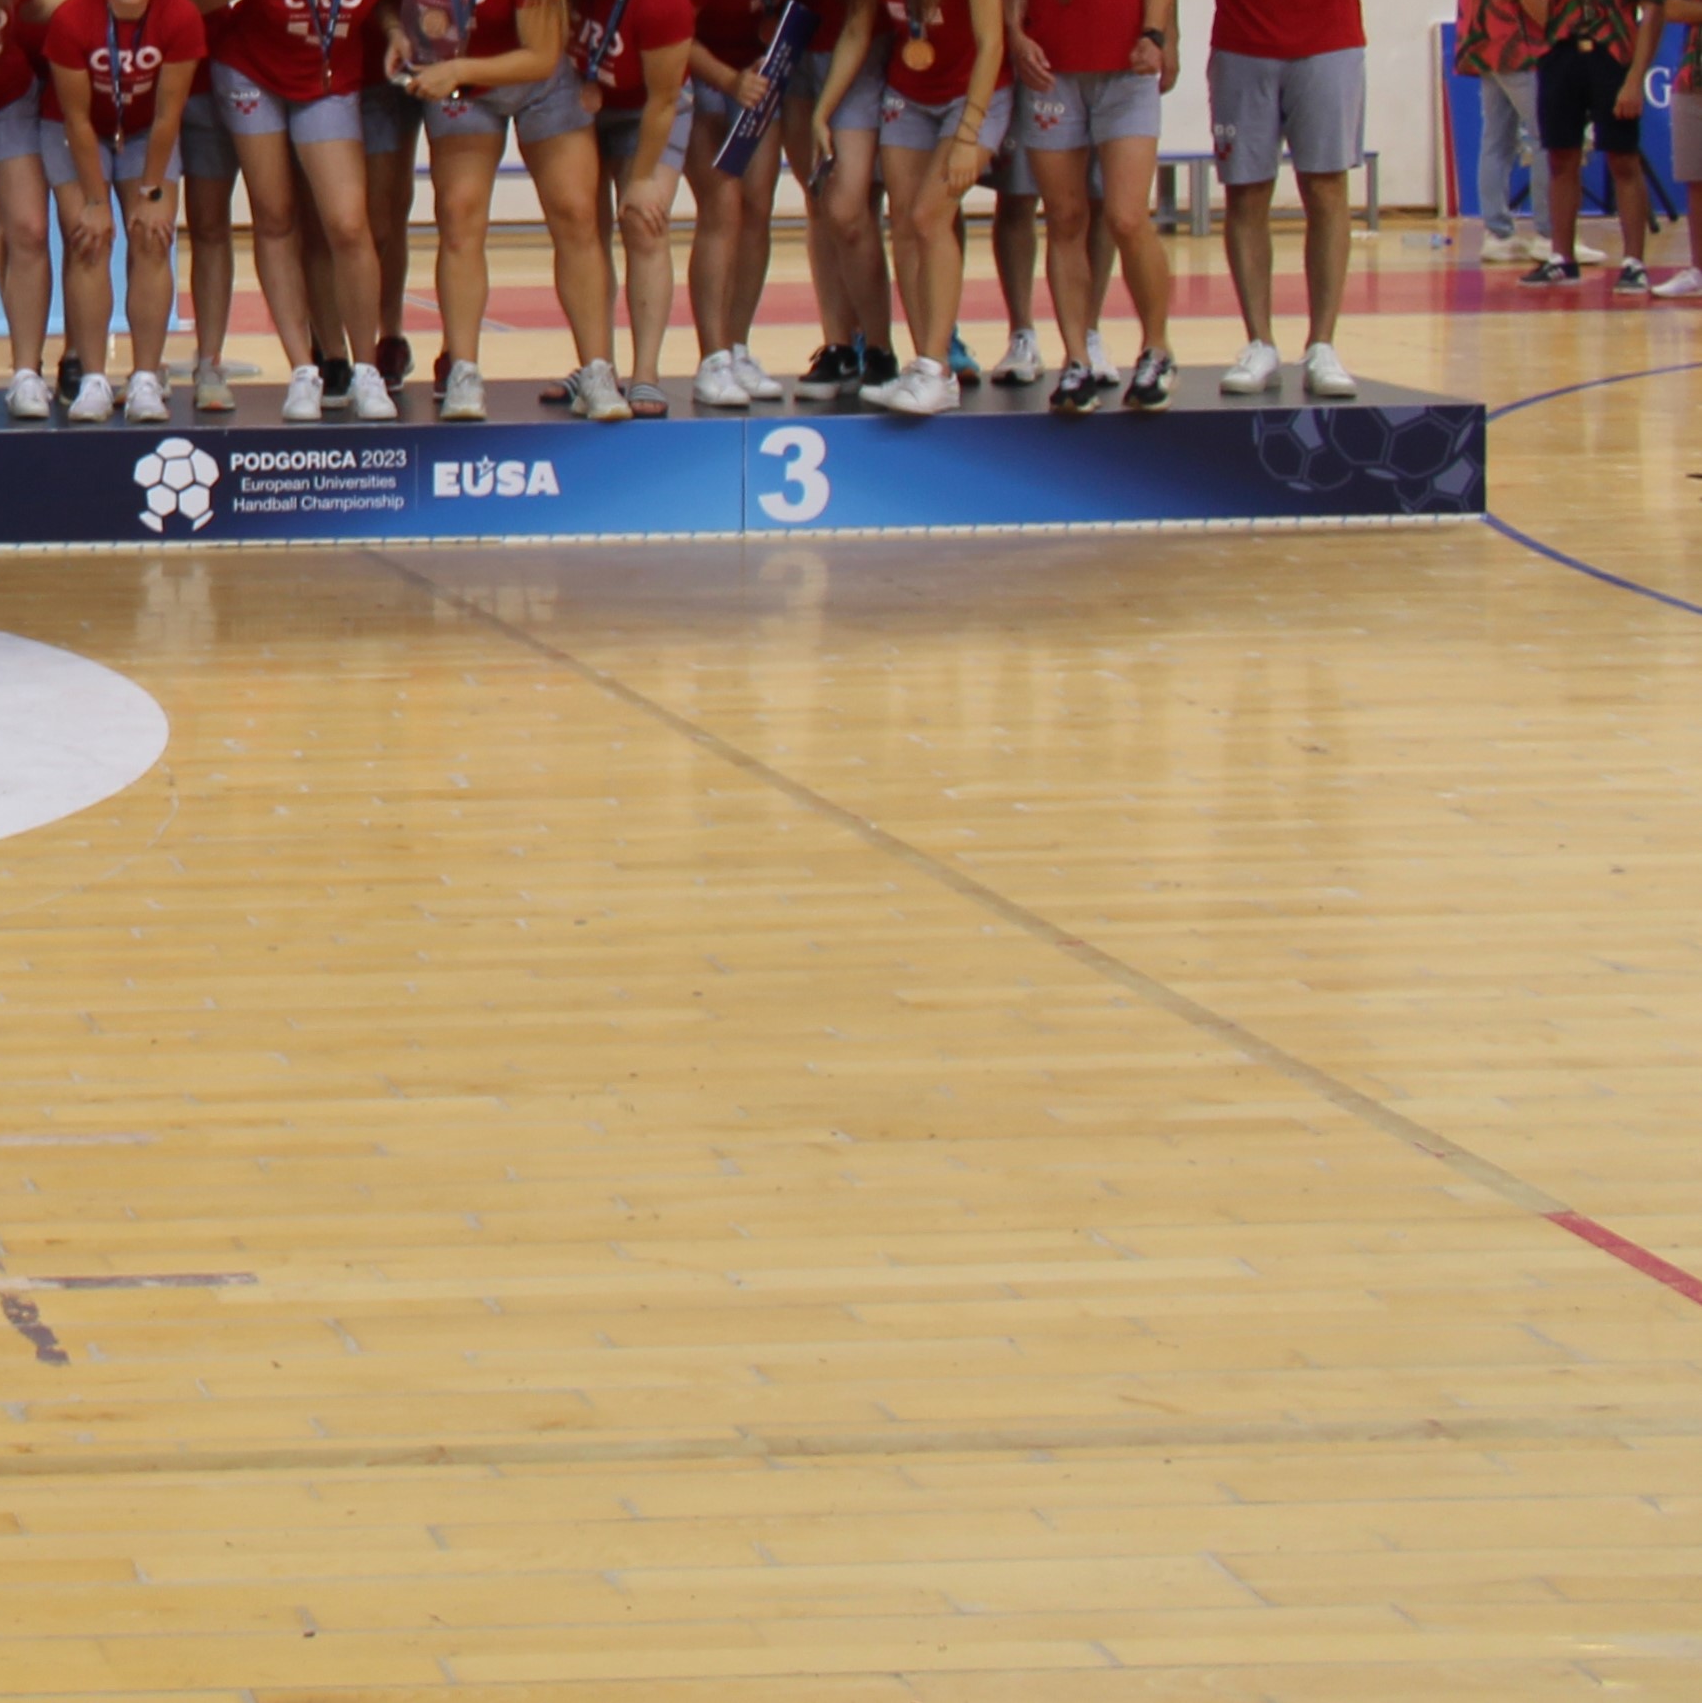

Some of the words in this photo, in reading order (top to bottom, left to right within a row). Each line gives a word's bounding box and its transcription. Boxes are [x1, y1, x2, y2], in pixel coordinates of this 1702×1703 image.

[89, 46, 163, 72] CRO
[230, 450, 357, 472] PODGORICA
[361, 449, 408, 468] 2023
[241, 476, 310, 494] European
[313, 474, 397, 491] Universities
[433, 455, 560, 497] EUSA
[758, 425, 830, 522] 3
[233, 496, 297, 513] Handball
[300, 494, 404, 512] Championship
